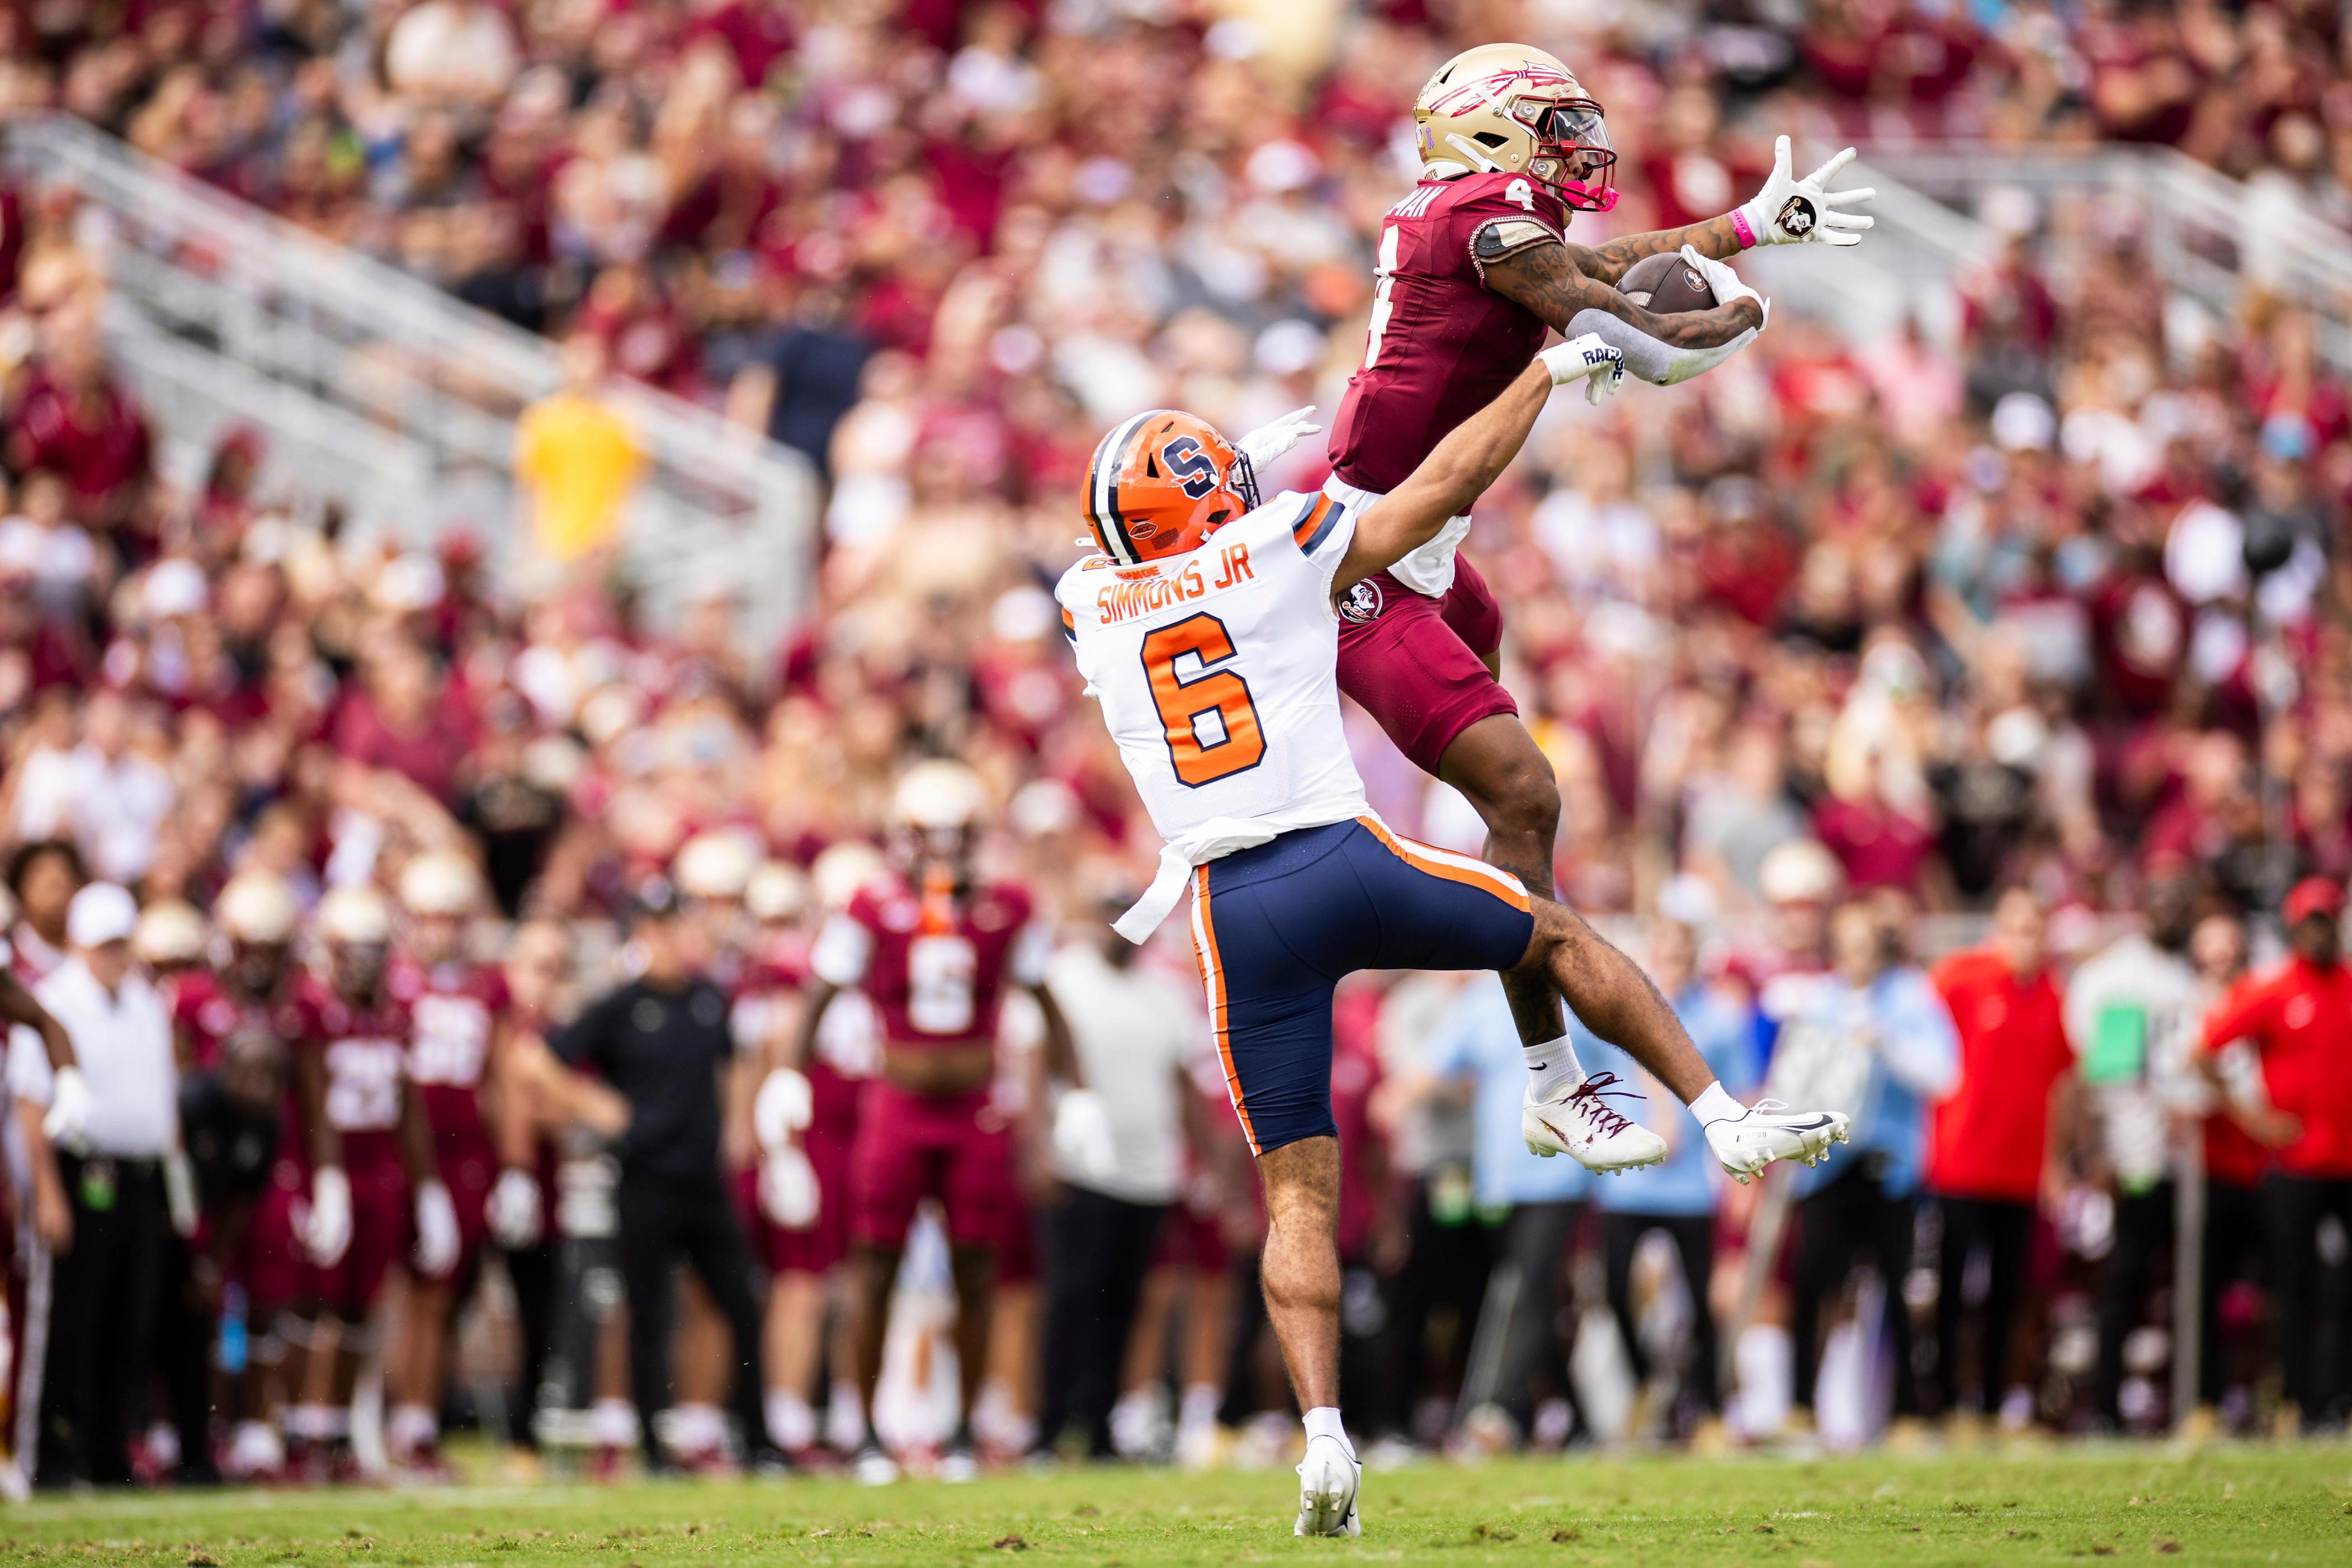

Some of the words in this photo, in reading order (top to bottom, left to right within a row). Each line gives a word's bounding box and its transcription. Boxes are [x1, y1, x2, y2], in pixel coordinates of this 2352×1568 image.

[1385, 186, 1447, 218] MAN
[1505, 178, 1536, 211] 4
[1161, 434, 1219, 500] S
[1134, 524, 1153, 536] ACC
[1097, 560, 1205, 624] SIMMONS
[1215, 543, 1254, 589] JR
[1114, 565, 1161, 580] RANGE
[1140, 611, 1268, 789] 6
